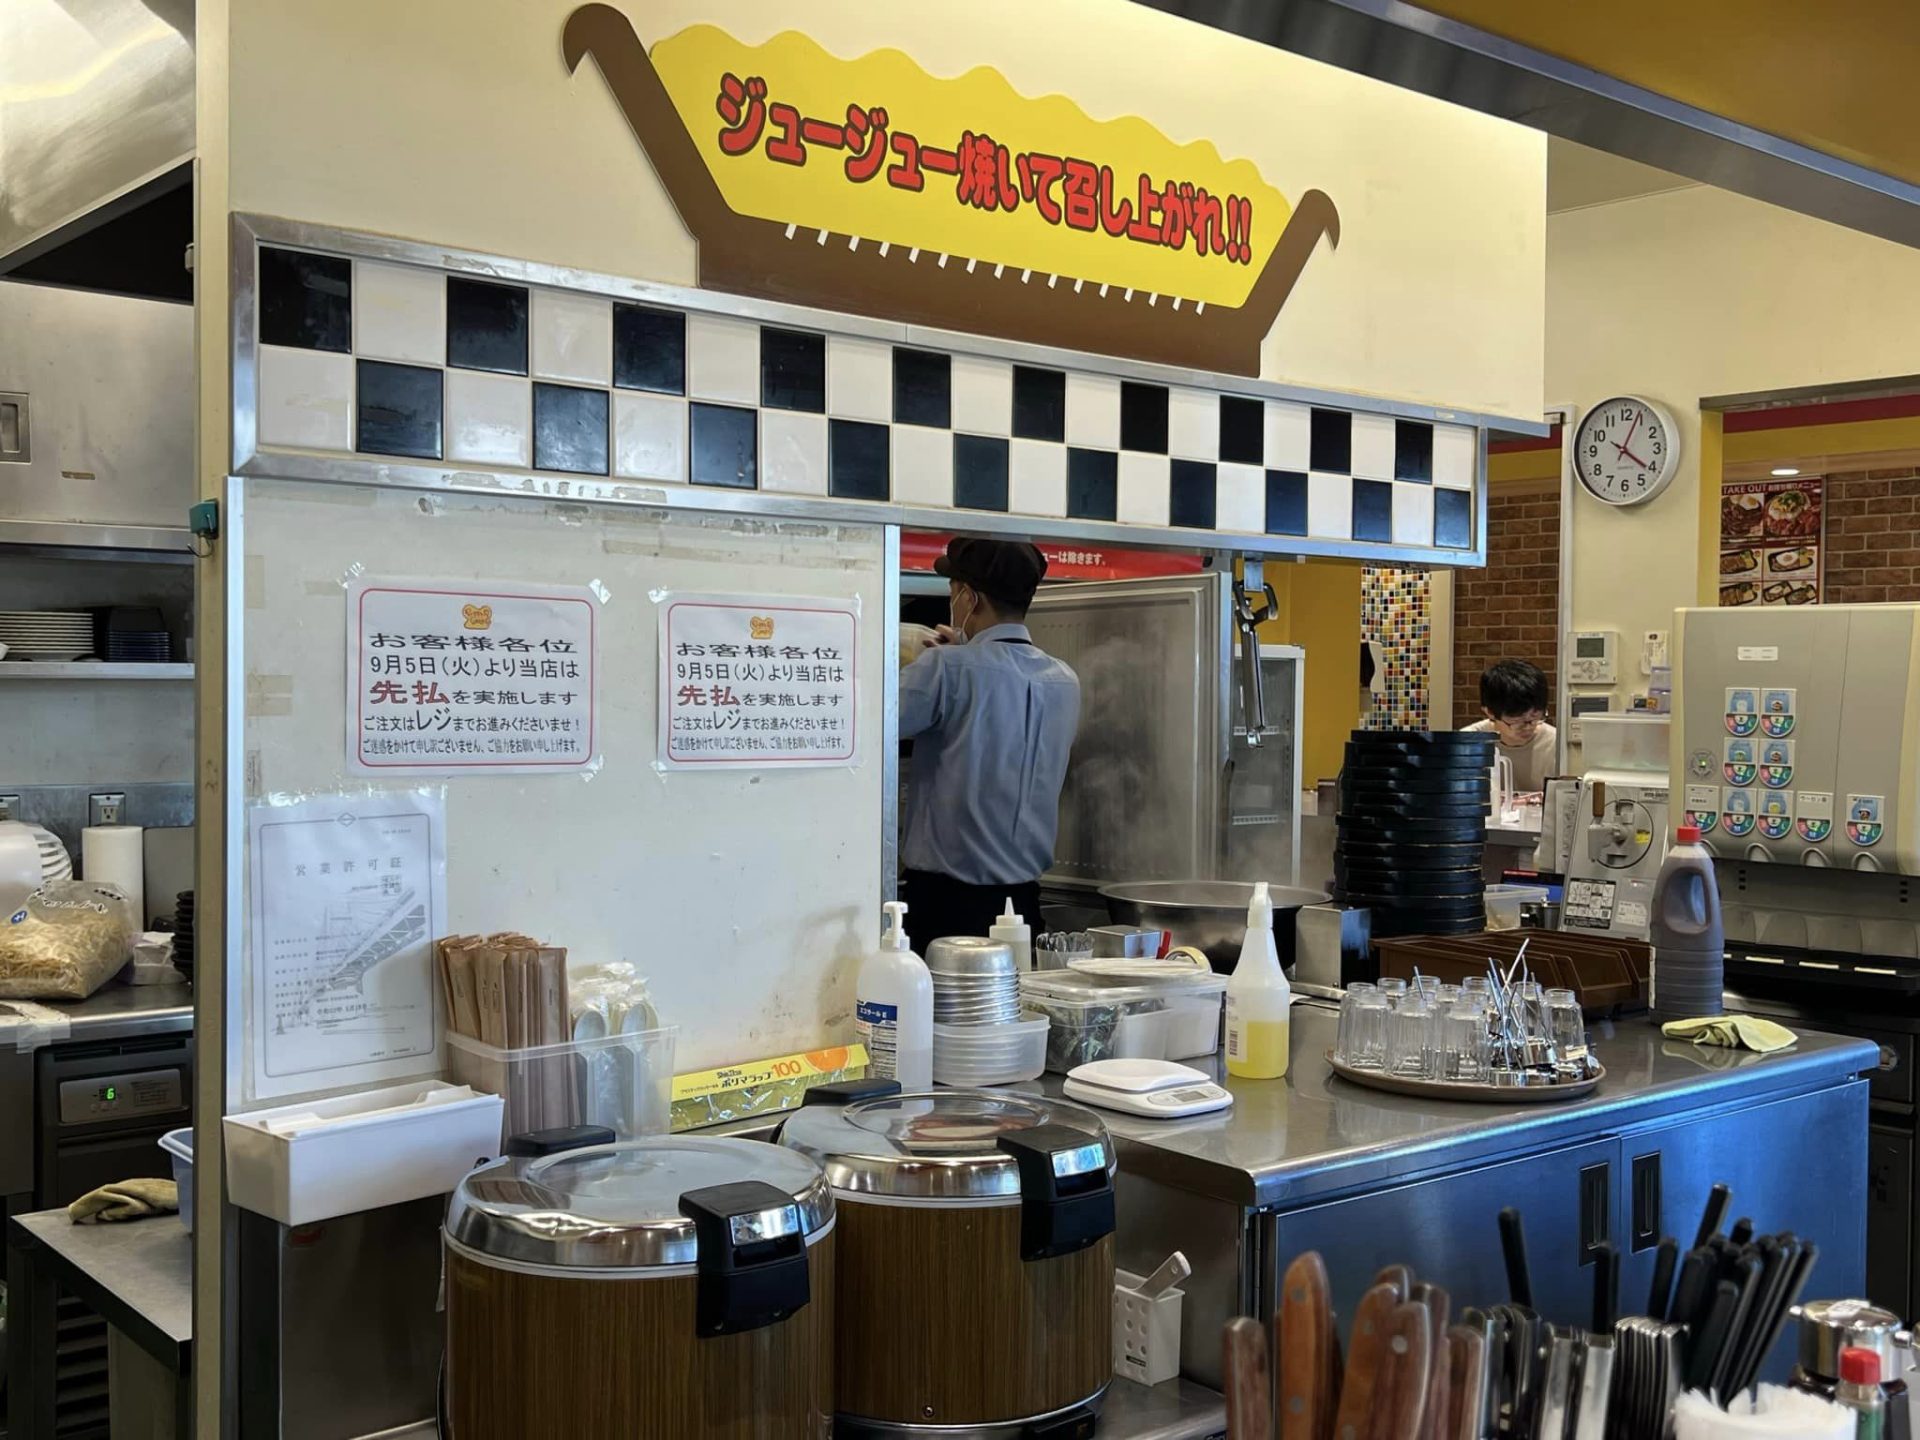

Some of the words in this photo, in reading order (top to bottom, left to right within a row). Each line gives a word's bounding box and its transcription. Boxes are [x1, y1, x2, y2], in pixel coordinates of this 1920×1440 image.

[716, 71, 1254, 266] ジュージュー焼いて召し上がれ!!
[1606, 414, 1615, 428] 11
[1620, 408, 1633, 421] 12
[1594, 429, 1606, 442] 10
[1648, 426, 1657, 439] 2
[1589, 445, 1598, 458] 9
[1652, 442, 1662, 455] 3
[1593, 463, 1602, 476] 8
[1648, 460, 1657, 472] 4
[1605, 475, 1615, 488] 7
[1620, 479, 1629, 492] 6
[1637, 473, 1646, 486] 5
[370, 633, 578, 654] お客様各位
[676, 642, 842, 660] お客様各位
[371, 654, 580, 679] 9月5日（火）より当店は
[677, 662, 844, 683] 9月5日（火）より当店は
[370, 680, 578, 705] 先払を実施します
[677, 685, 843, 707] 先払を実施します
[771, 1060, 801, 1078] 100
[106, 1087, 115, 1100] 6
